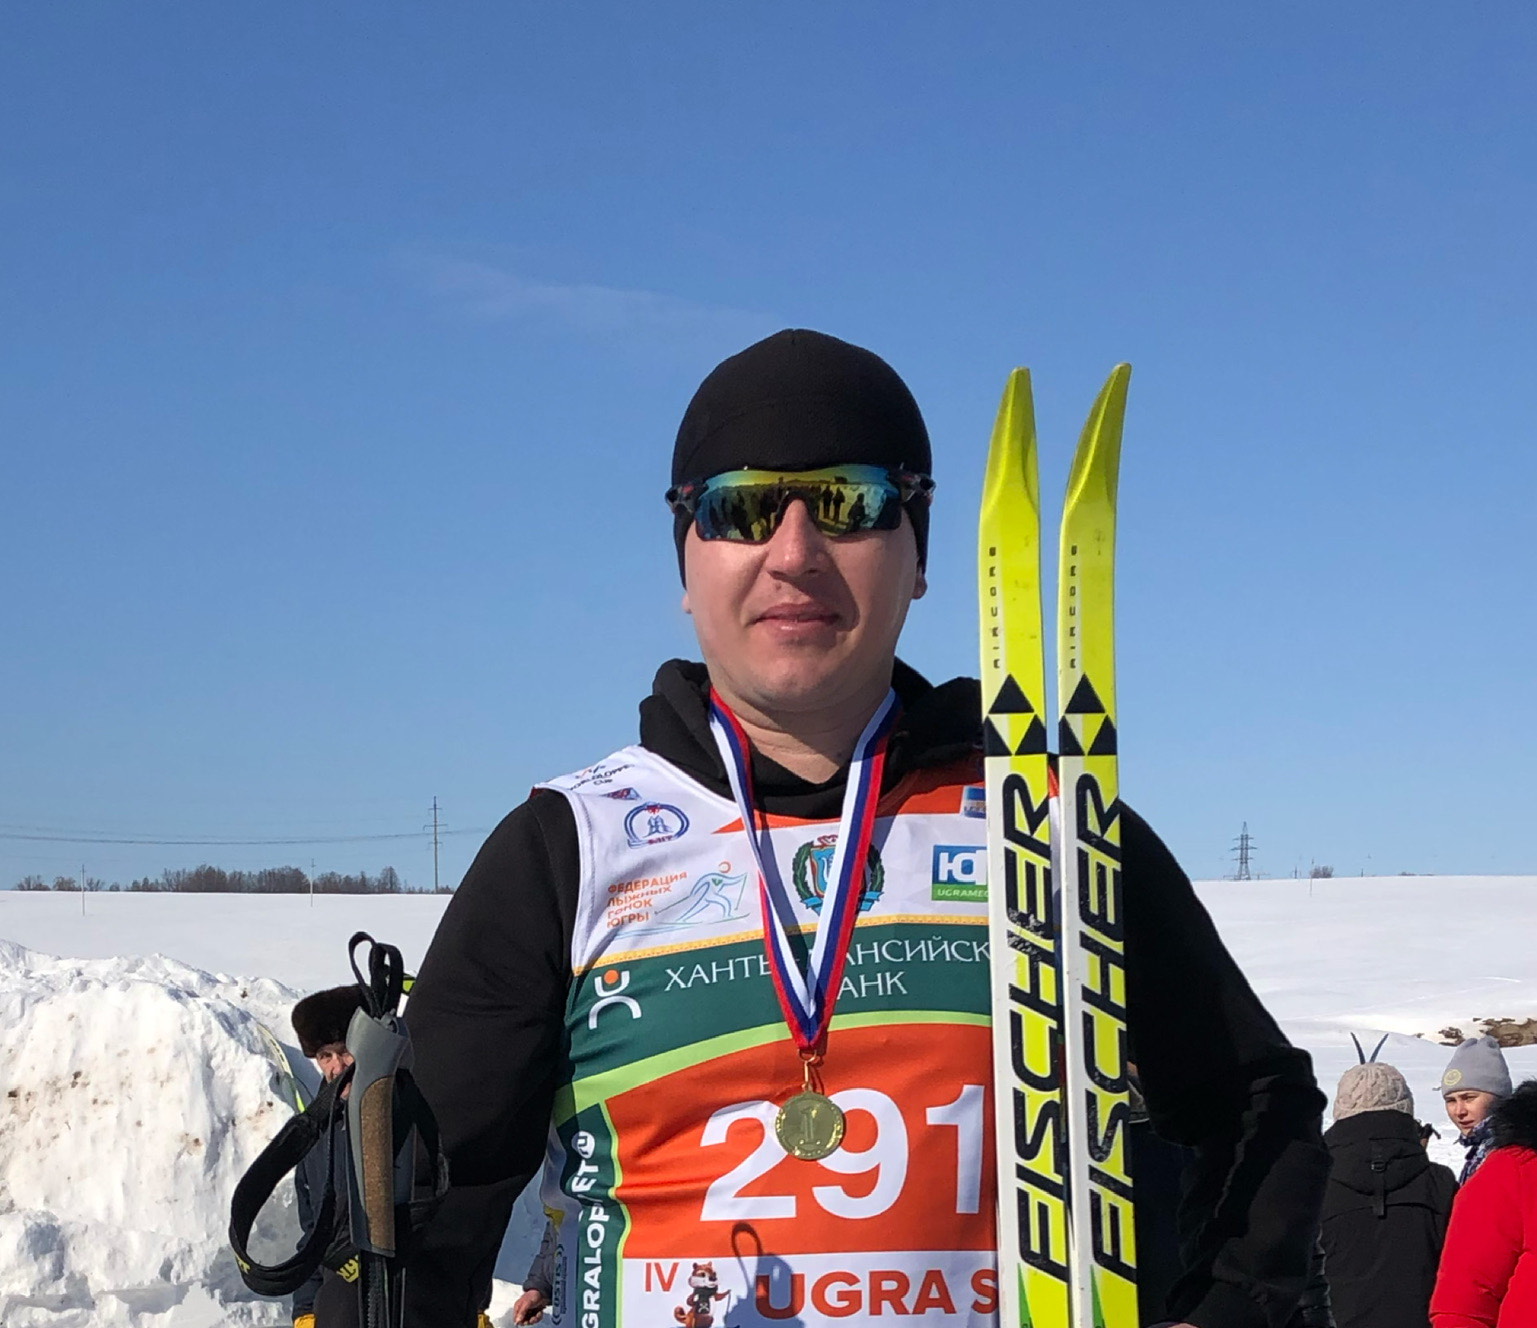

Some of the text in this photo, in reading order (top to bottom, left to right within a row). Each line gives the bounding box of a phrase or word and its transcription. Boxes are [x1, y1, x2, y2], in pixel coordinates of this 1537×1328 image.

[607, 872, 687, 893] ФЕДЕРАЦИЯ
[607, 885, 671, 907] ЛЫЖНЫХ
[607, 911, 639, 928] ЮГРЫ
[608, 899, 652, 918] ГОНОК
[837, 971, 908, 999] АНК
[1002, 772, 1070, 1283] FISCHER
[1075, 771, 1137, 1285] FISCHER
[700, 1085, 985, 1222] 291
[644, 1262, 679, 1292] IV
[756, 1269, 956, 1319] UGRA
